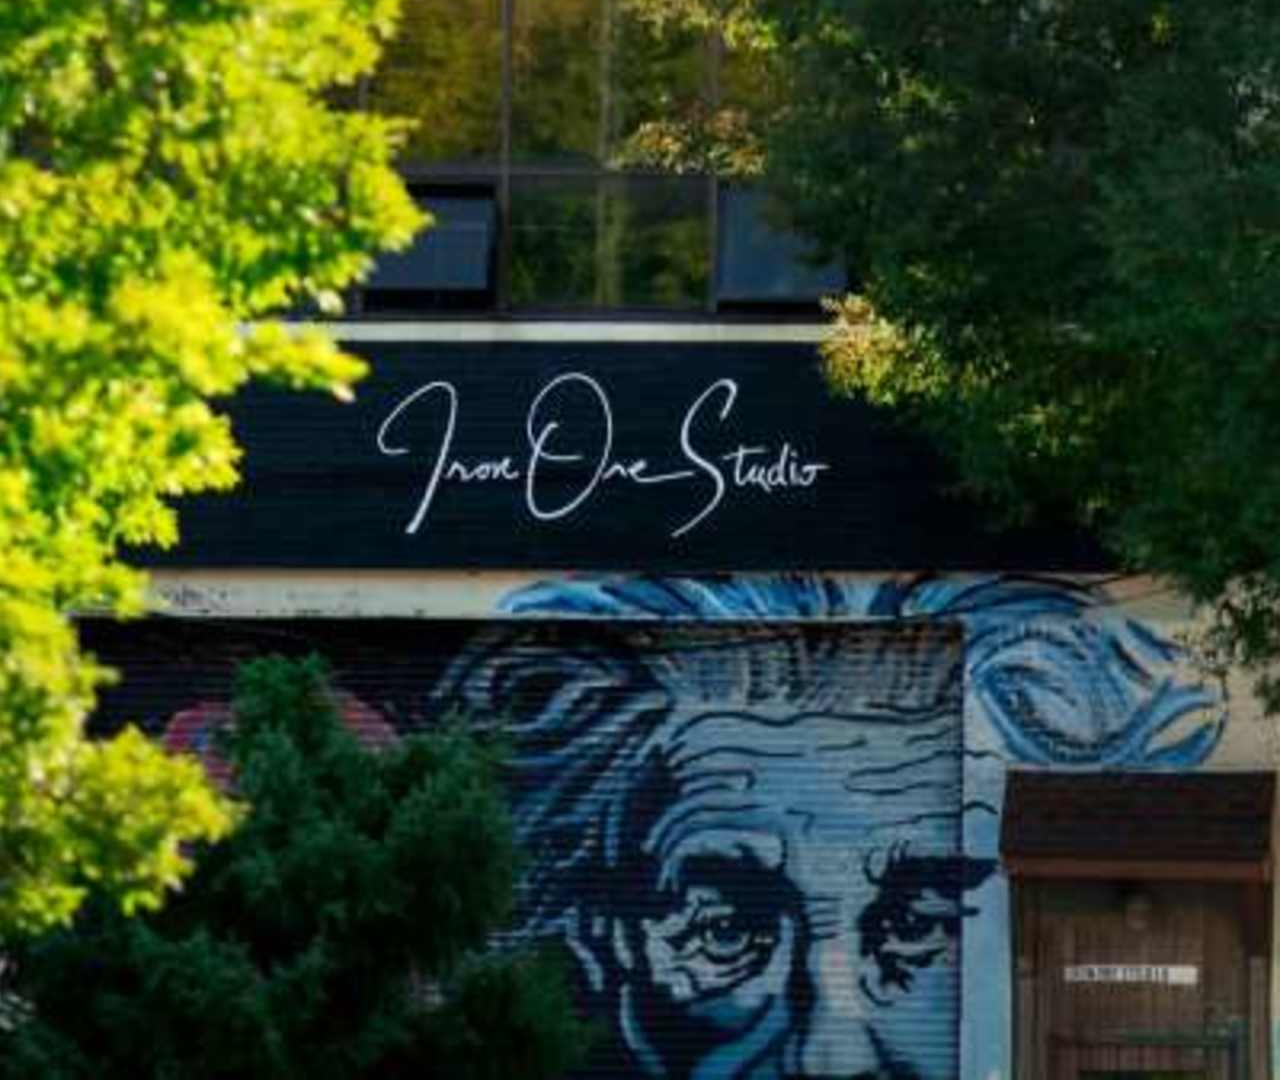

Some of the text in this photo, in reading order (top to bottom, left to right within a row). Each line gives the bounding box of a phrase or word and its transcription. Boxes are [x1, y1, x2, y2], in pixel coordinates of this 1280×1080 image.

[377, 372, 829, 536] Iron Ore Studio
